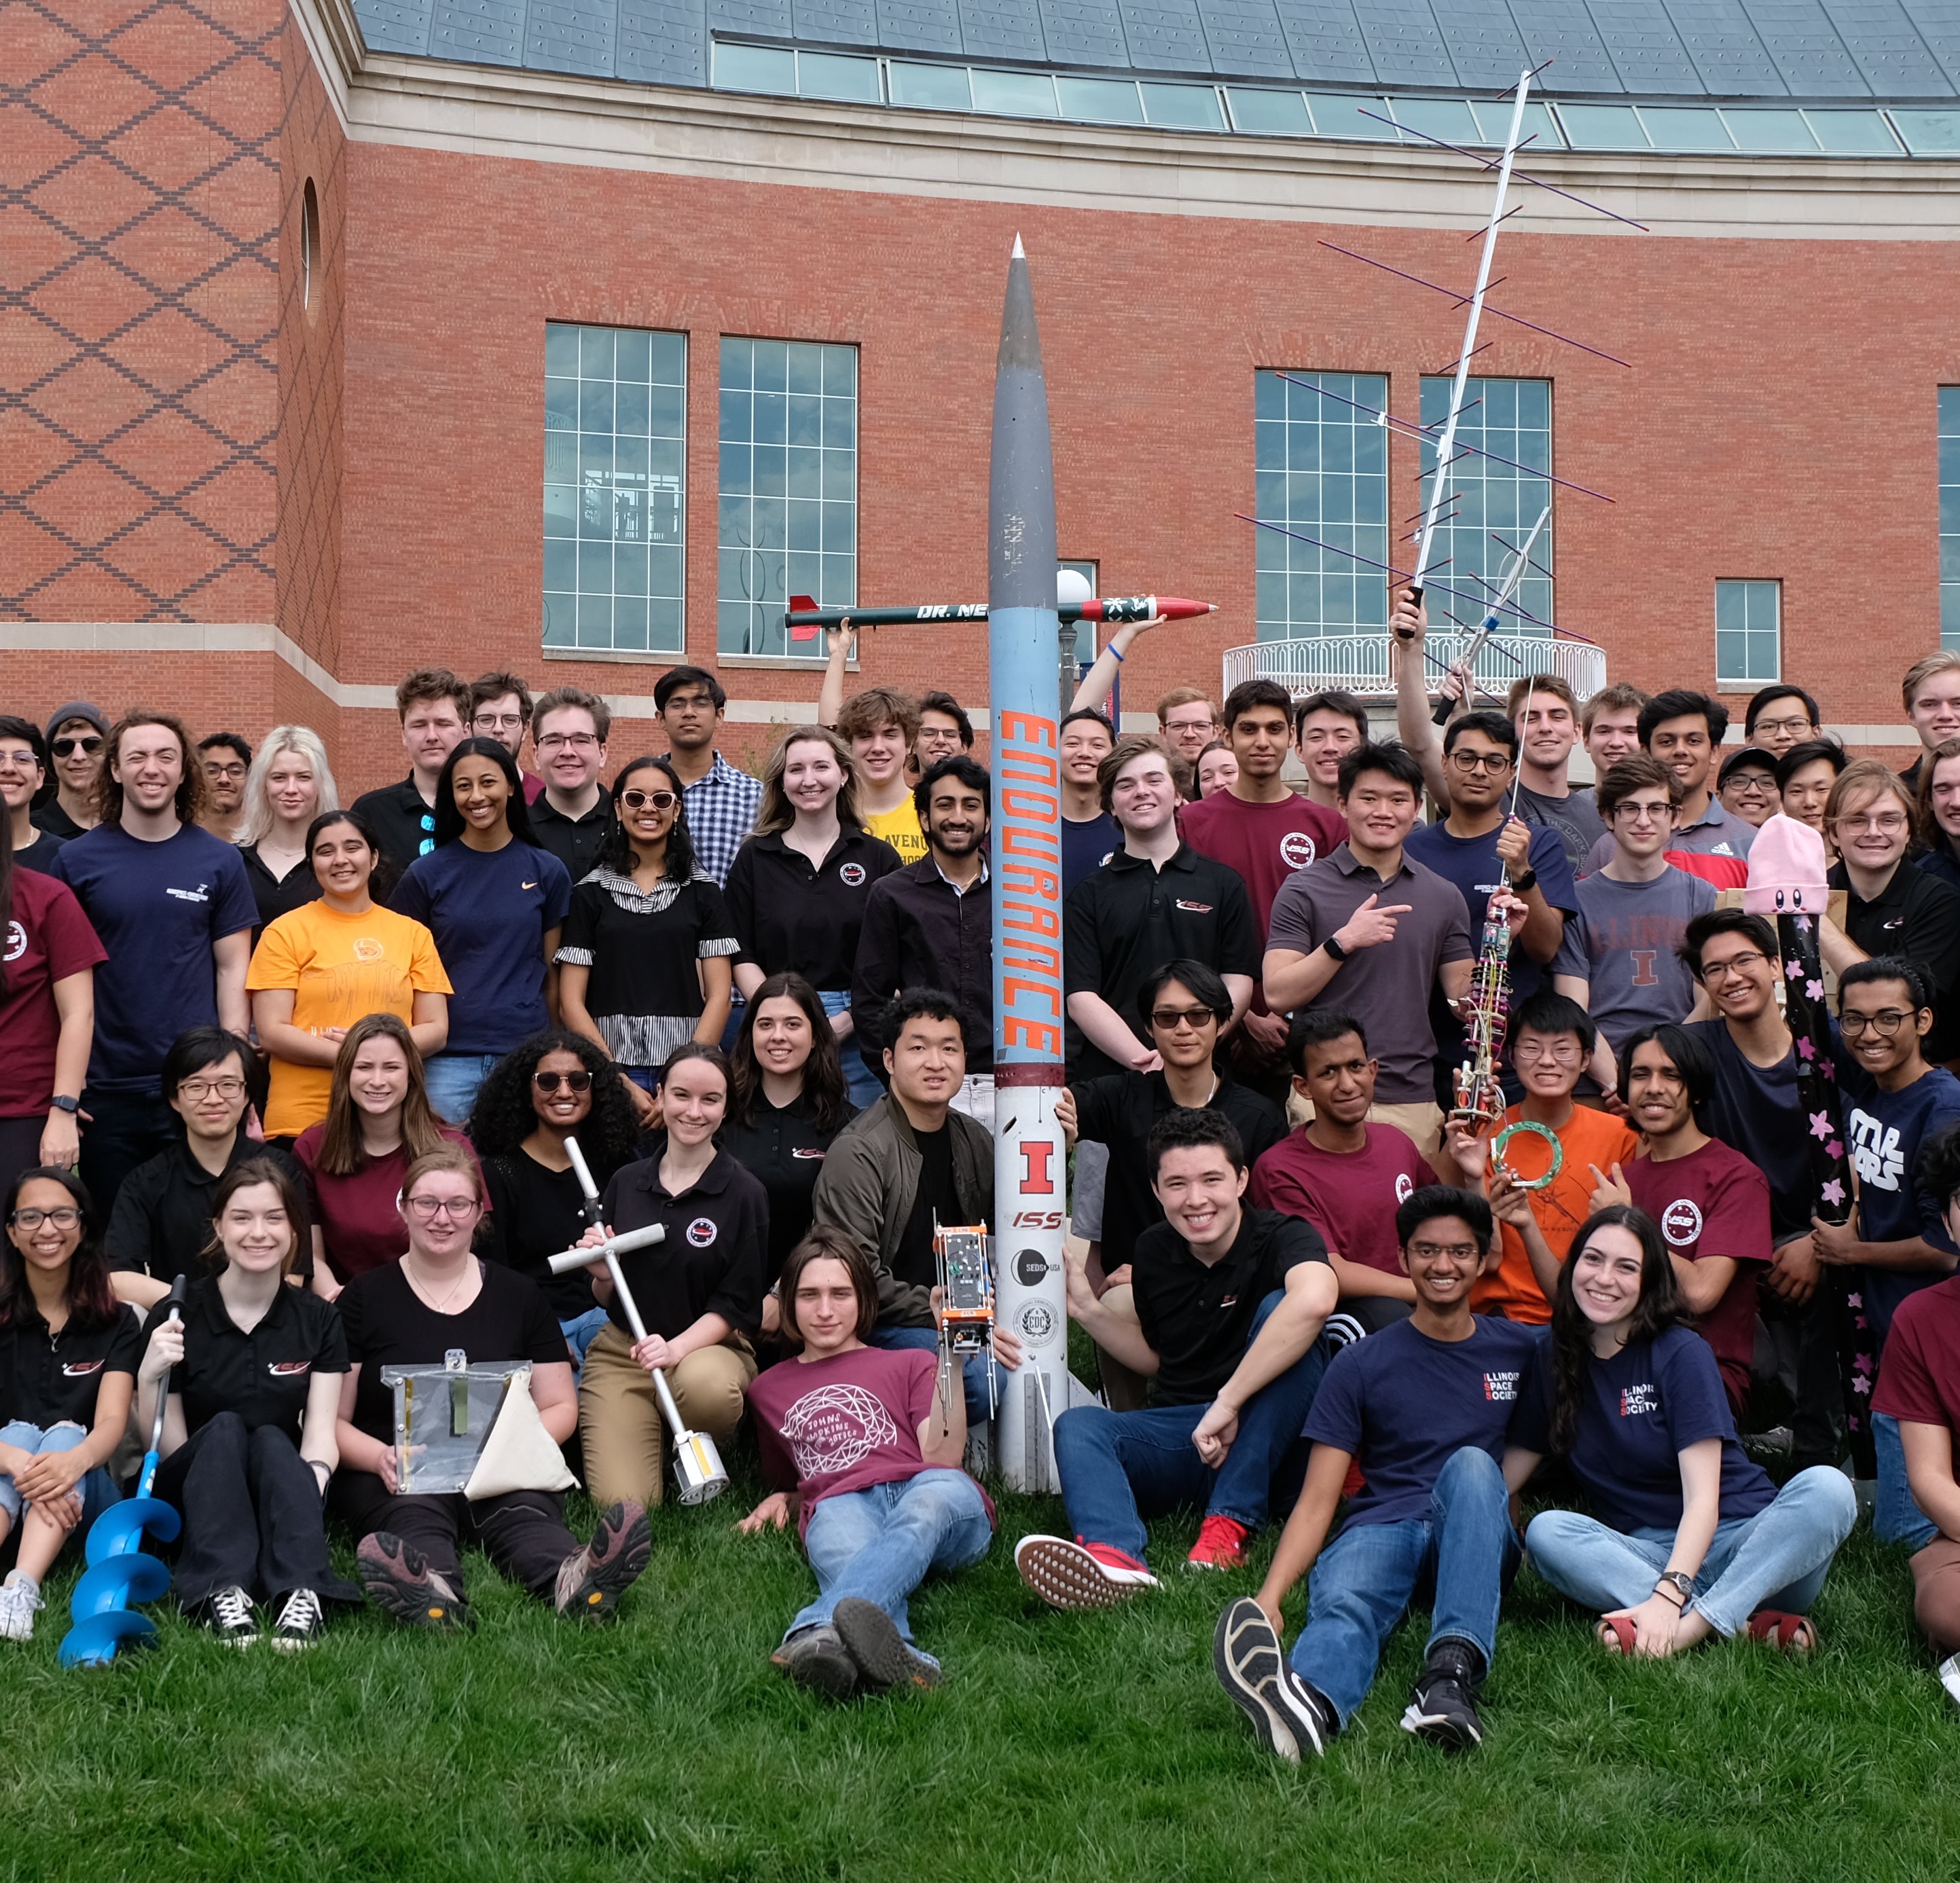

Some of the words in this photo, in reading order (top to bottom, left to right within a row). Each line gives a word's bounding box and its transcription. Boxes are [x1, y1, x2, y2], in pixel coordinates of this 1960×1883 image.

[916, 605, 951, 619] DR.
[957, 604, 989, 617] NE
[1565, 826, 1586, 852] DARK
[1001, 710, 1061, 1056] ENDURANCE
[1631, 950, 1658, 986] I
[1019, 1141, 1053, 1194] I
[1852, 1139, 1904, 1191] ARS
[1012, 1212, 1063, 1230] ISS
[1026, 1264, 1044, 1272] SEDS
[1050, 1264, 1060, 1272] USA
[1029, 1316, 1045, 1329] EDC
[1484, 1381, 1512, 1391] SPACE
[1485, 1391, 1518, 1401] SOCIETY
[807, 1412, 841, 1431] JOHNS
